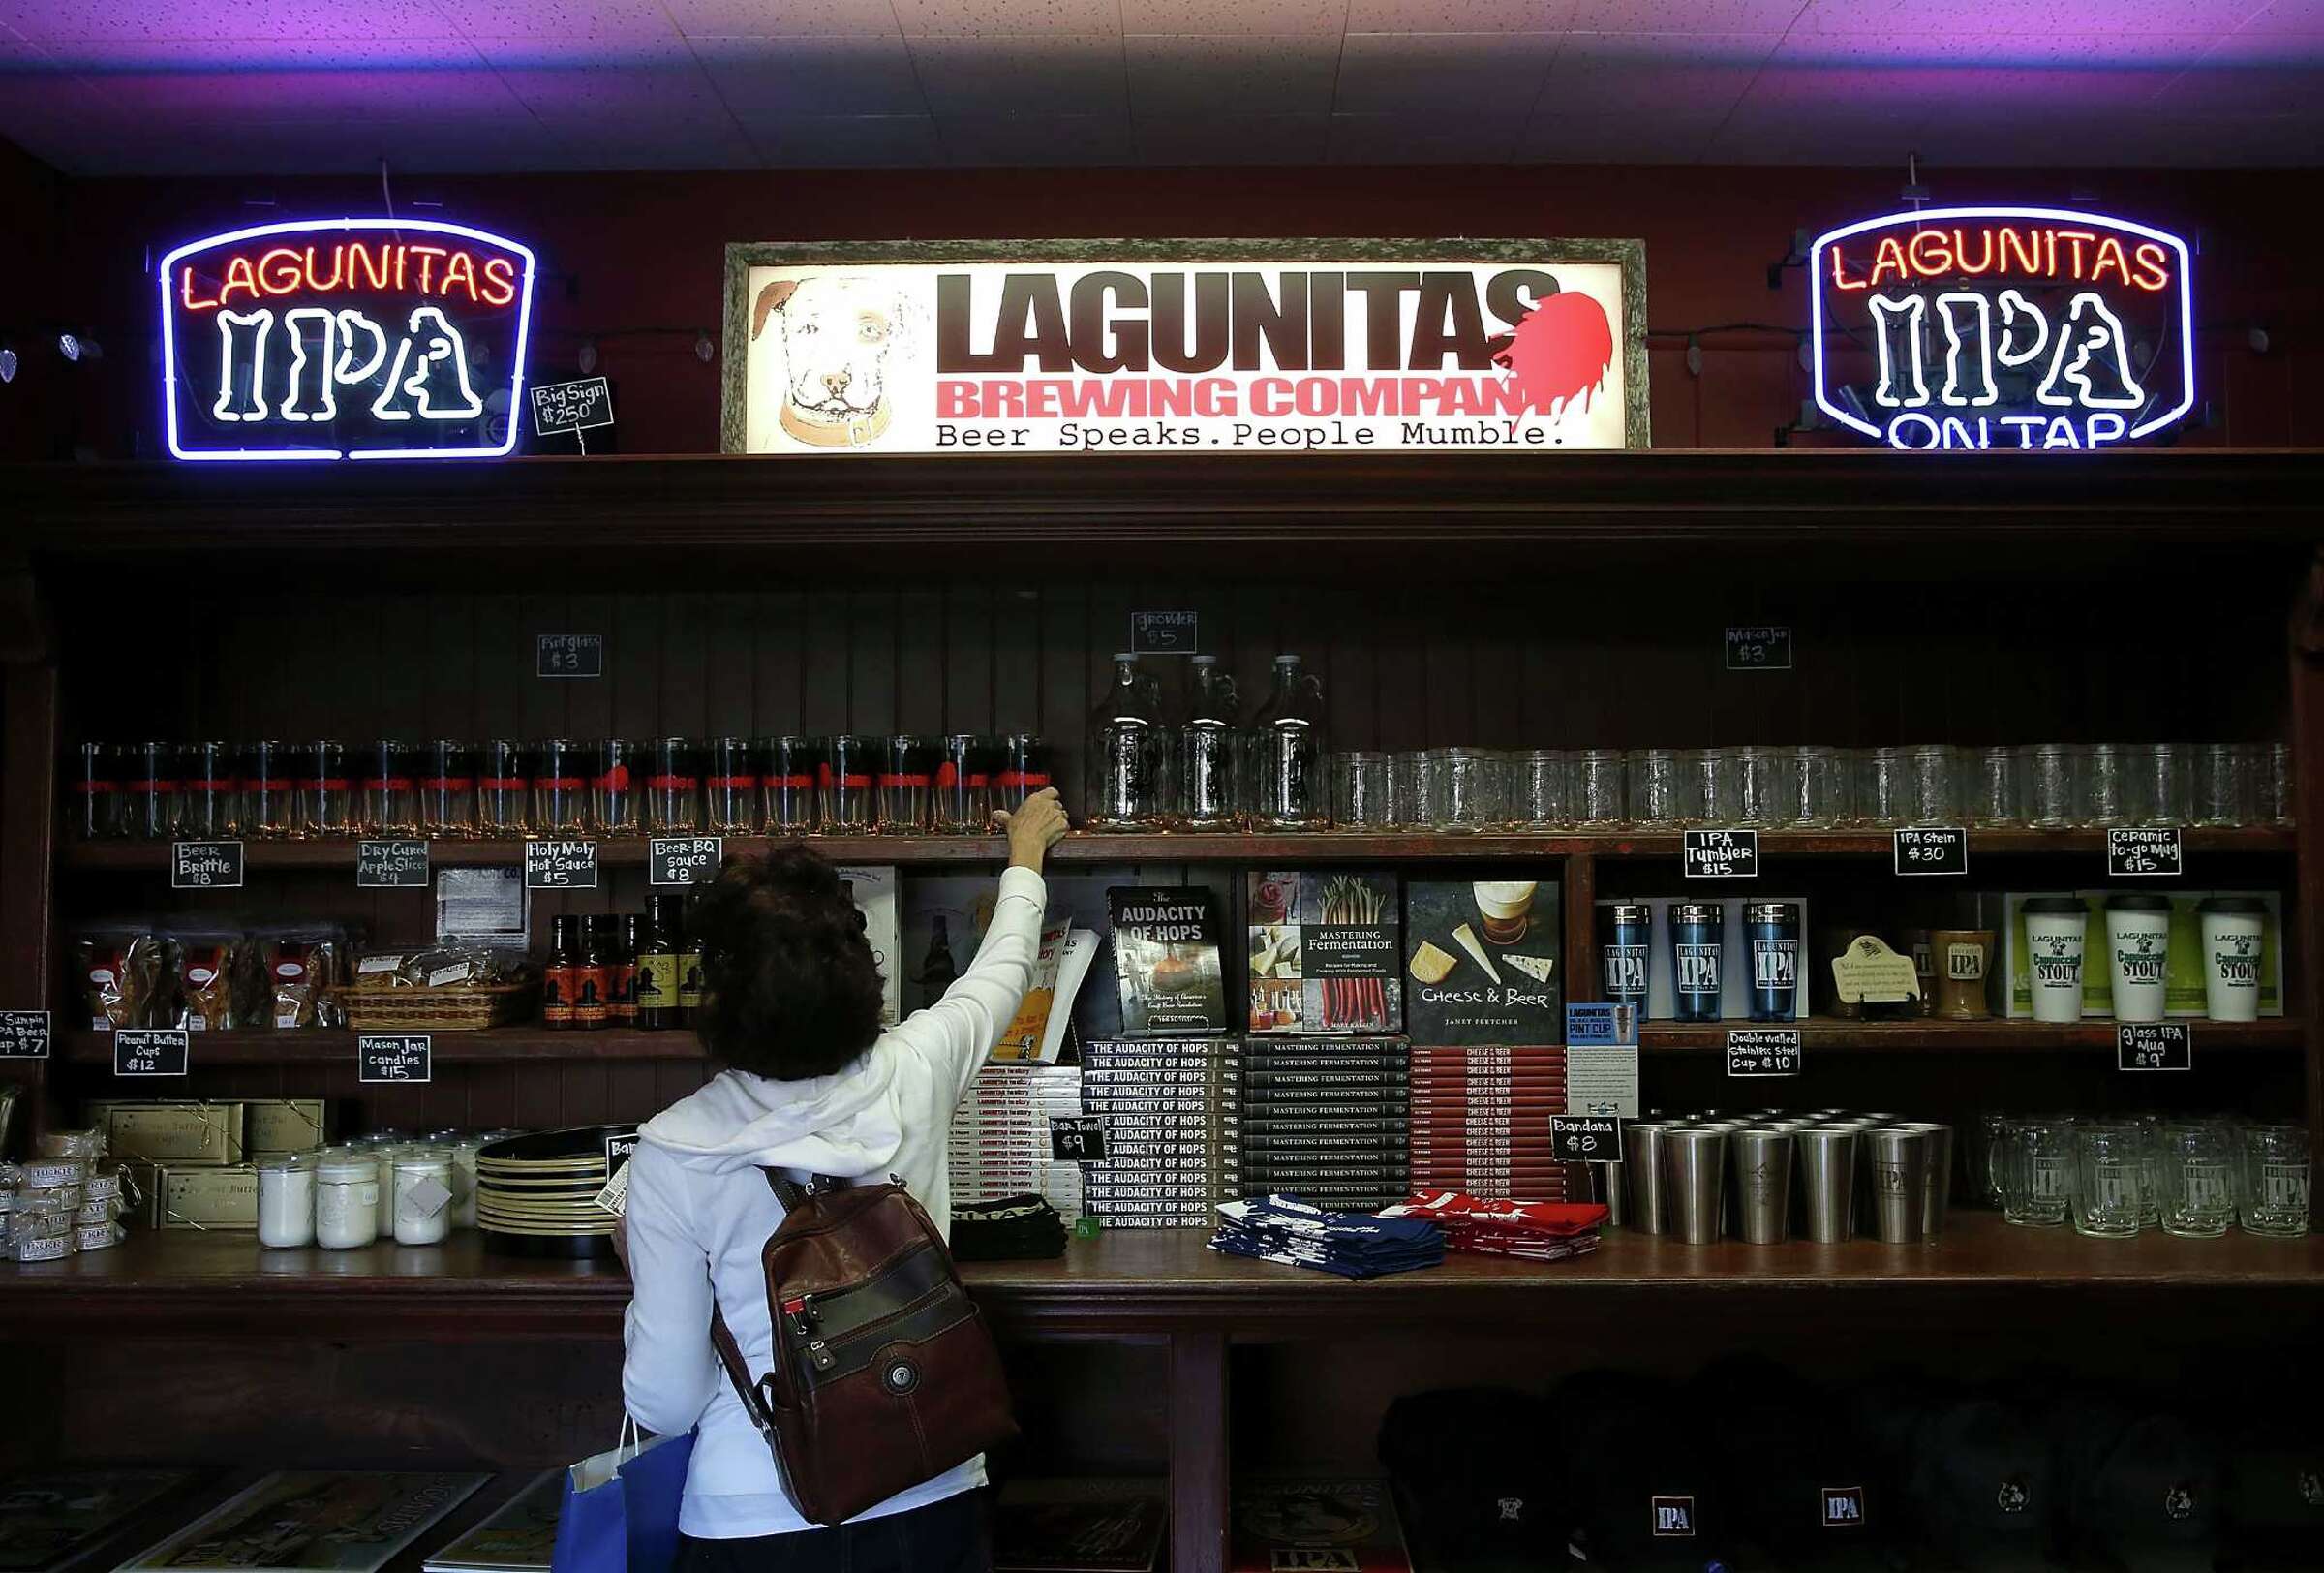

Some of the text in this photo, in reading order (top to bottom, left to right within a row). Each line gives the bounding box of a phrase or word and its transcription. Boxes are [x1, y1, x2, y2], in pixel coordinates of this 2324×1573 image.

[1832, 229, 2168, 290] LAGUNITAS
[181, 242, 515, 310] LAGUNITAS
[936, 269, 1561, 374] LAGUNITAS
[1867, 289, 2145, 410] IPA
[212, 306, 483, 422] IPA
[535, 384, 604, 407] Big Sign
[936, 377, 1551, 418] BREWING COMPAN
[542, 403, 591, 425] $250
[936, 423, 1031, 447] Beer
[1401, 422, 1564, 446] Mumble.
[1888, 413, 2125, 450] ON TAP
[551, 650, 580, 670] $3
[1735, 642, 1766, 663] $3
[1700, 832, 1733, 847] IPA
[1900, 831, 1956, 844] IPA Stein
[2112, 828, 2171, 842] Ceramic
[178, 843, 221, 860] Beer
[361, 843, 390, 860] Dry
[528, 841, 595, 861] Holy Moly
[655, 840, 715, 856] Beer-BQ
[1686, 846, 1754, 863] Tumbler
[1908, 847, 1945, 861] $30
[2110, 842, 2179, 861] to-go Mug
[180, 857, 232, 875] Brittle
[360, 860, 394, 875] Apple
[528, 857, 595, 872] Hot Sauce
[667, 854, 707, 868] sauce
[1703, 862, 1733, 875] $15
[2124, 856, 2157, 872] $15
[193, 872, 211, 885] $8
[543, 871, 569, 885] $5
[666, 868, 689, 881] $8
[1121, 905, 1206, 922] AUDACITY
[1130, 924, 1203, 941] OF HOPS
[1319, 931, 1381, 940] MASTERING
[1308, 939, 1393, 951] Fermentation
[1607, 956, 1646, 987] IPA
[1679, 956, 1719, 986] IPA
[1756, 951, 1795, 981] IPA
[1950, 954, 1980, 974] IPA
[1486, 987, 1500, 1003] &
[16, 1027, 47, 1036] Beer
[1569, 1023, 1611, 1033] PINT CUP
[2161, 1027, 2183, 1040] IPA
[18, 1036, 45, 1053] $7
[118, 1033, 185, 1046] Peanut Butter
[361, 1038, 427, 1055] Mason Jar
[1729, 1033, 1763, 1044] Double
[136, 1045, 161, 1059] Cups
[1094, 1043, 1208, 1053] THE AUDACITY OF HOPS
[1729, 1045, 1798, 1056] Stainless Steel
[2137, 1039, 2165, 1056] Mug
[126, 1058, 155, 1071] $12
[369, 1054, 420, 1064] candles
[1093, 1058, 1207, 1067] THE AUDACITY OF HOPS
[1731, 1056, 1790, 1071] Cup $10
[2135, 1053, 2160, 1067] $9
[381, 1065, 410, 1079] $15
[1091, 1072, 1206, 1082] THE AUDACITY OF HOPS
[1091, 1087, 1204, 1096] THE AUDACITY OF HOPS
[1091, 1101, 1204, 1111] THE AUDACITY OF HOPS
[1553, 1118, 1613, 1132] Bandana
[1062, 1135, 1085, 1153] $9
[1567, 1135, 1597, 1152] $8
[1093, 1173, 1206, 1183] THE AUDACITY OF HOPS
[1093, 1187, 1206, 1197] THE AUDACITY OF HOPS
[1827, 1497, 1859, 1519] IPA
[1658, 1507, 1689, 1529] IPA
